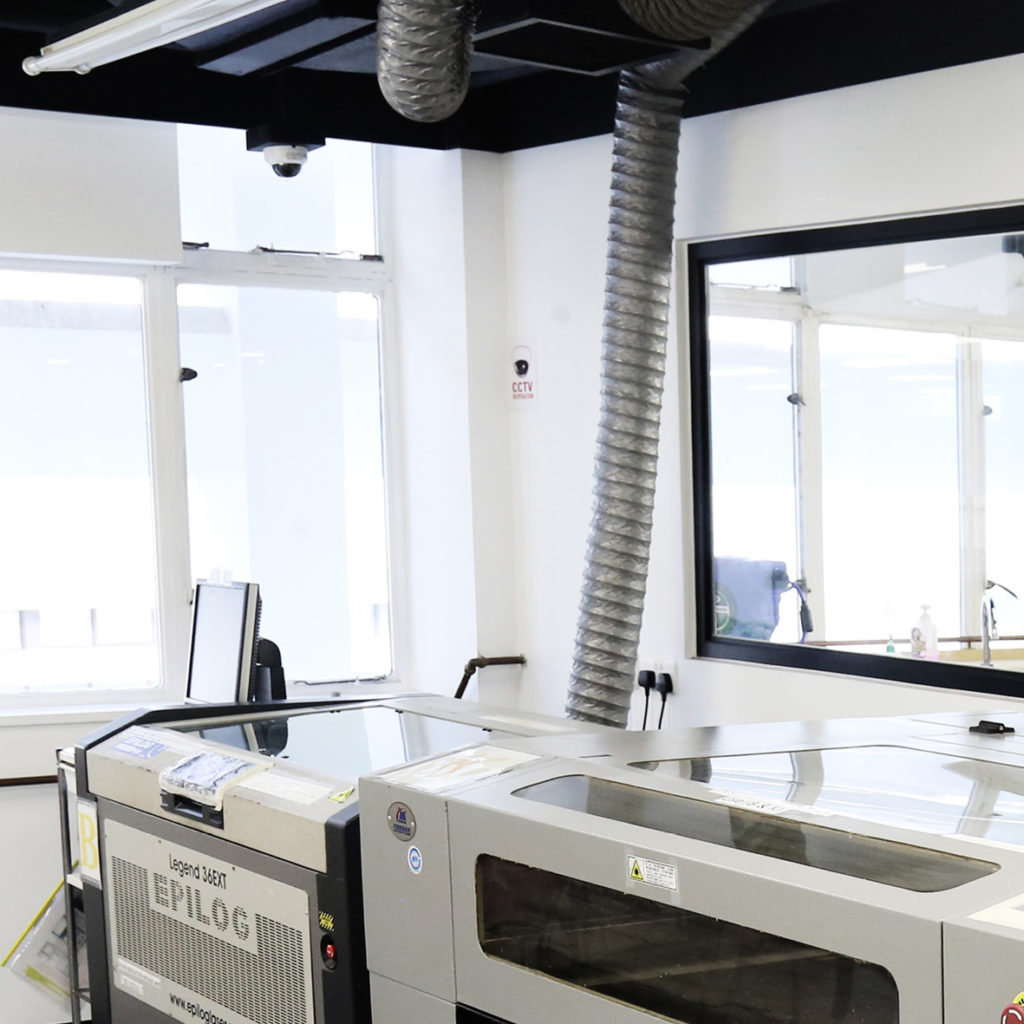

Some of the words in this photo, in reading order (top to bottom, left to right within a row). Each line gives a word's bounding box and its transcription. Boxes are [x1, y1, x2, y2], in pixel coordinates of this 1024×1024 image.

[512, 381, 533, 393] CCTV
[78, 813, 98, 869] B
[169, 853, 200, 880] Legend
[202, 866, 227, 889] 36EXT
[153, 872, 250, 941] EPILOG
